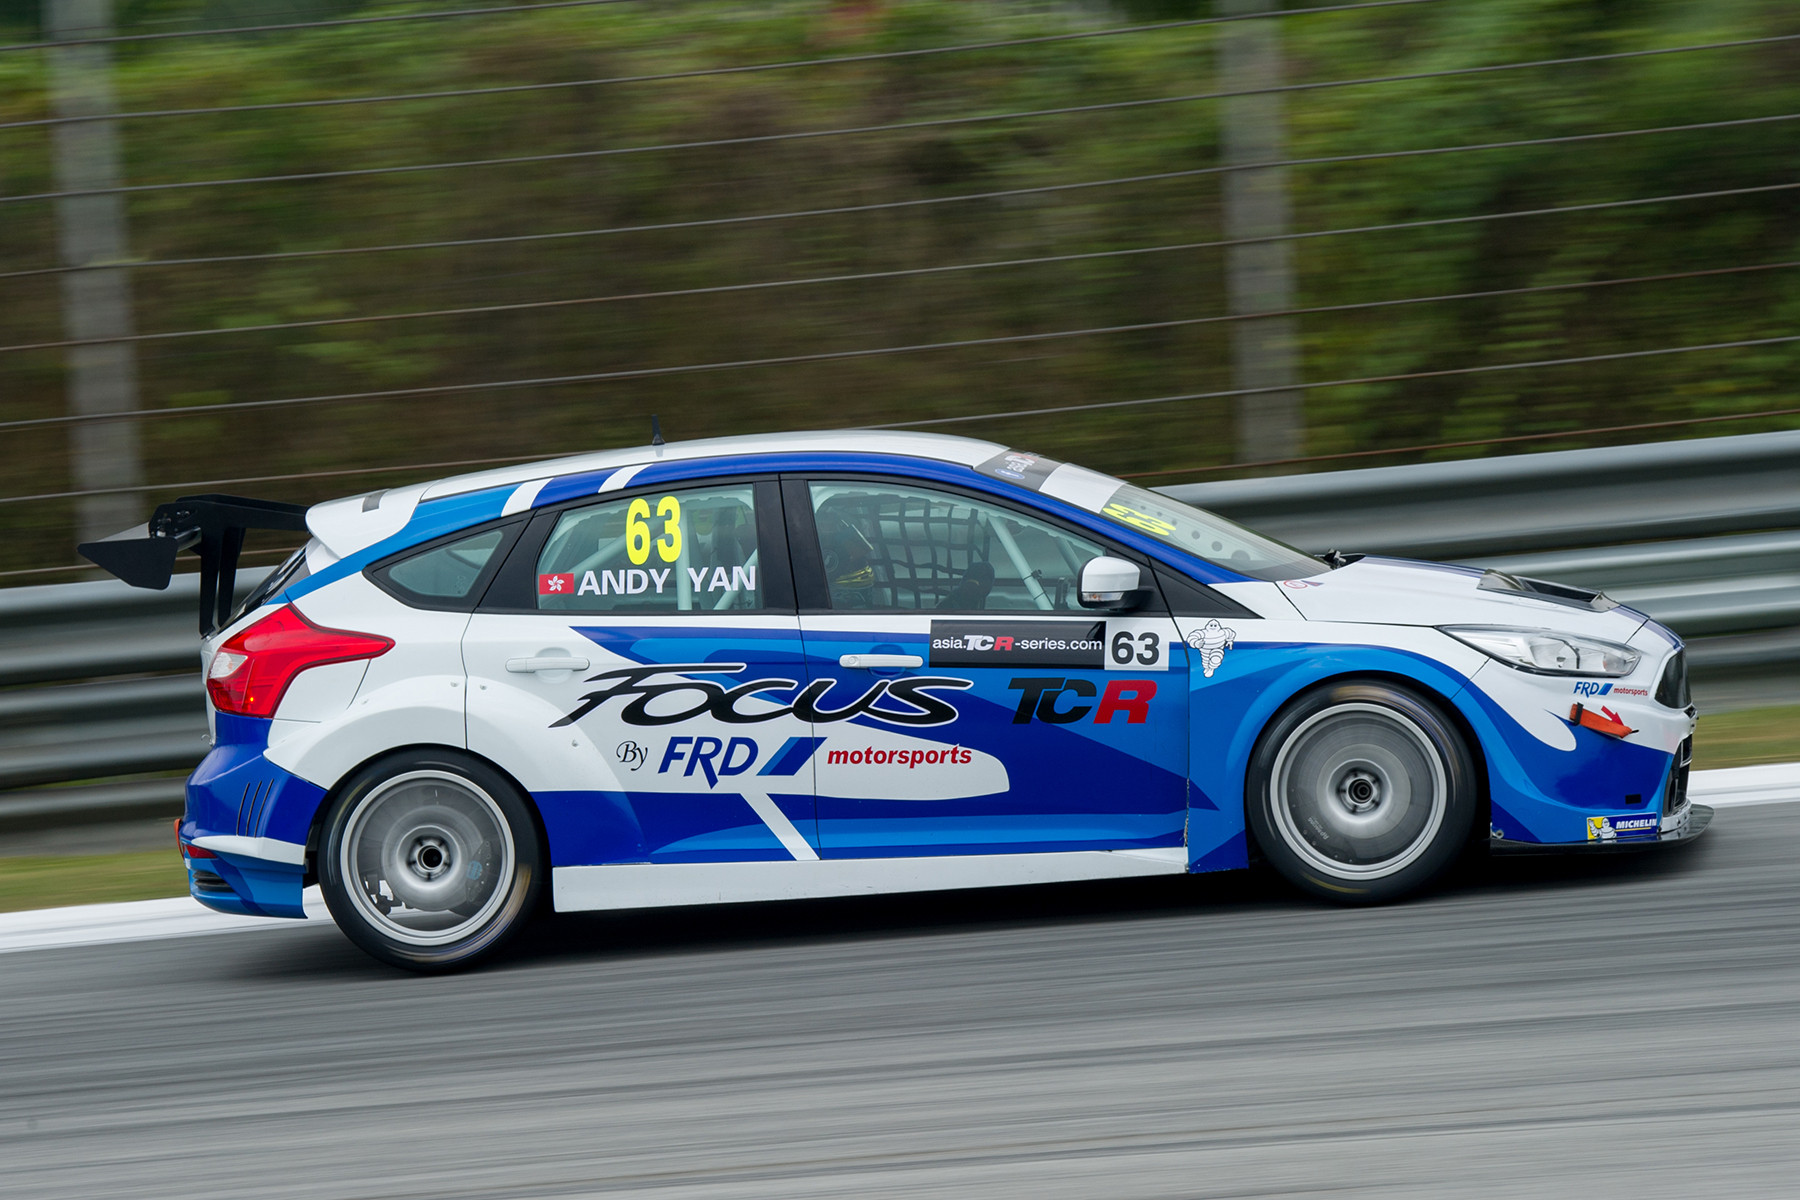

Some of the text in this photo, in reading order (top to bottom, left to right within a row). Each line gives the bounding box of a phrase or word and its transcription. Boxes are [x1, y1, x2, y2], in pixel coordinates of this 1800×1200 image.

[626, 496, 682, 566] 63
[577, 566, 756, 596] ANDY YAN
[932, 634, 1103, 652] asia.TCR-series.com
[1111, 631, 1160, 666] 63
[1007, 677, 1158, 724] TCR
[1573, 682, 1648, 698] FRD motorsports
[616, 736, 972, 790] By FRD motorsports
[1616, 818, 1656, 828] MICHELIN
